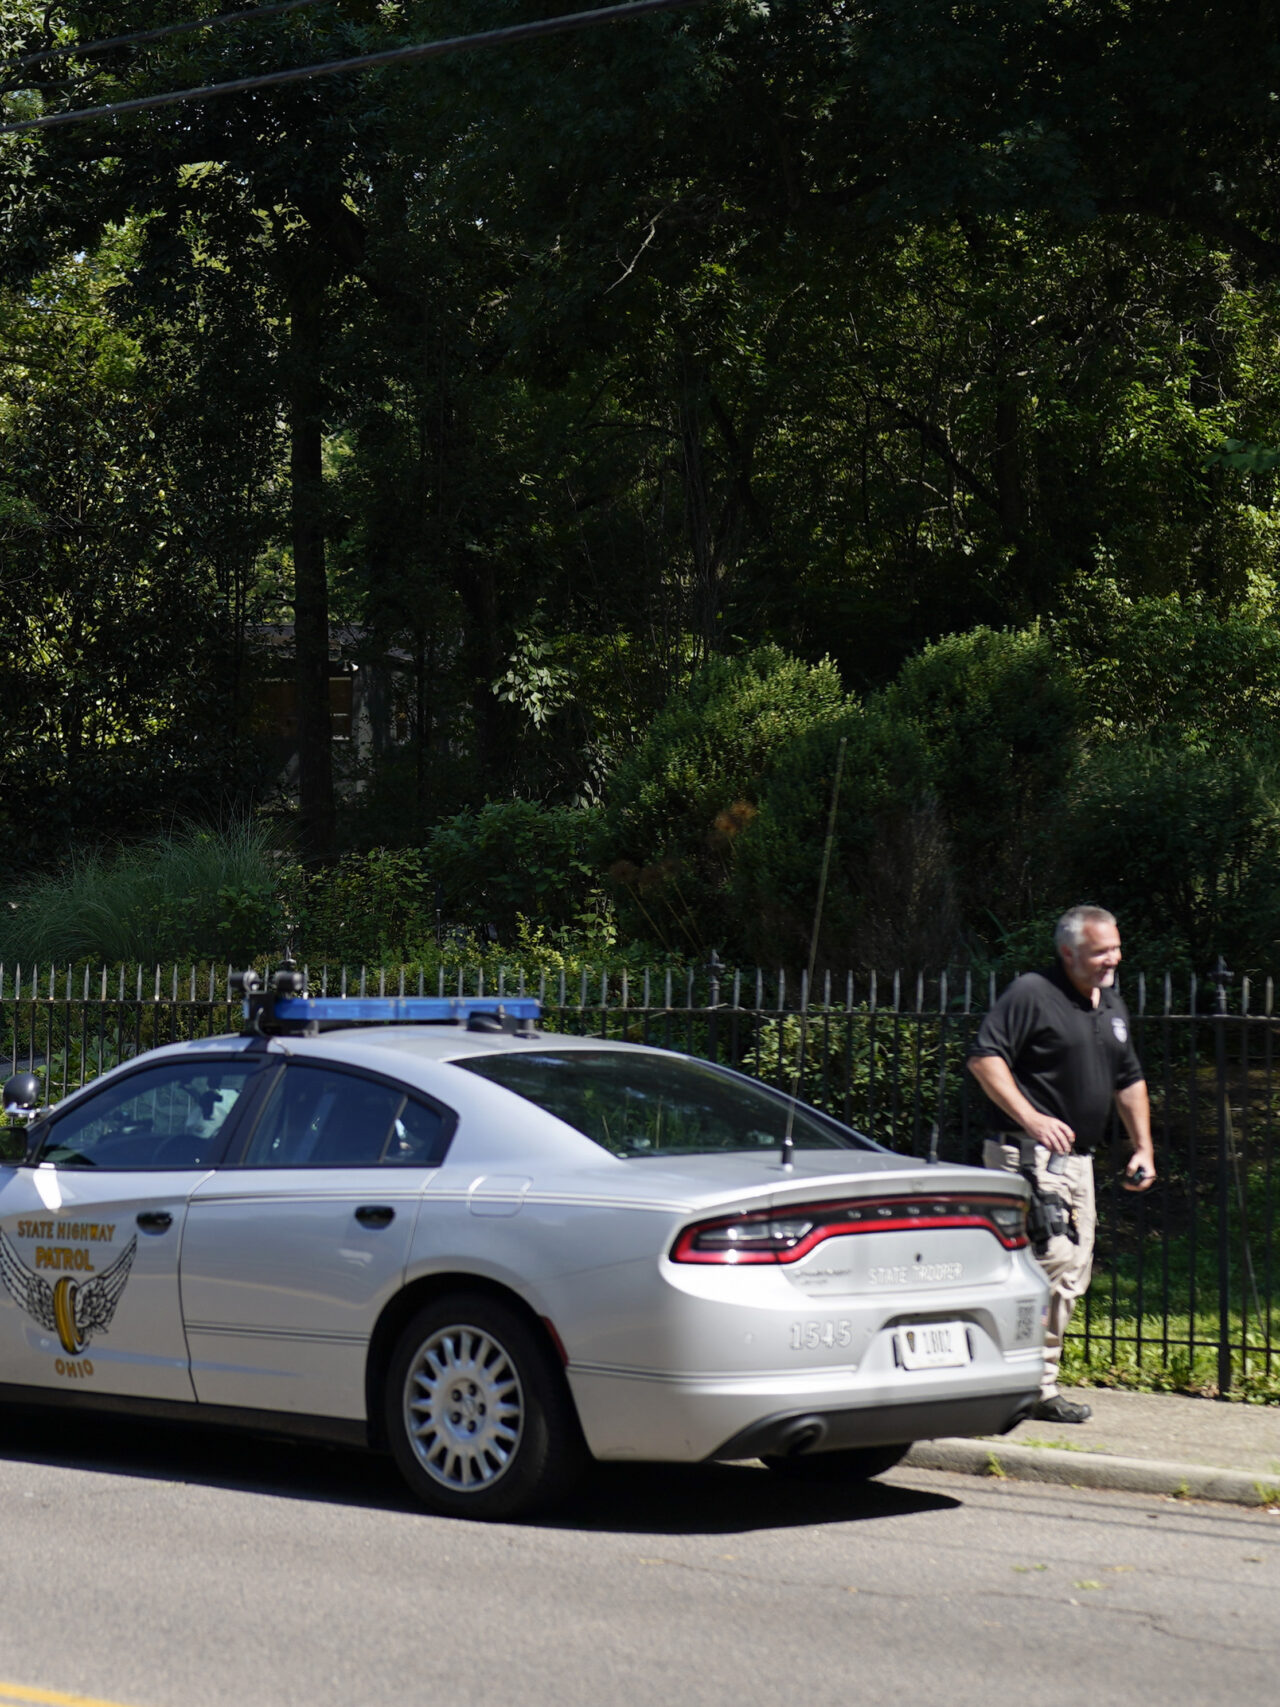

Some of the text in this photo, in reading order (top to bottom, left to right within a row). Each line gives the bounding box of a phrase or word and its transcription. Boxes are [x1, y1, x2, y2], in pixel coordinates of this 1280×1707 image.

[18, 1220, 116, 1242] STATE HIGHWAY
[35, 1246, 95, 1272] PATROL
[869, 1265, 908, 1286] STATE
[912, 1262, 963, 1282] TROOPER
[790, 1319, 853, 1351] 1545
[55, 1358, 94, 1378] OHIO
